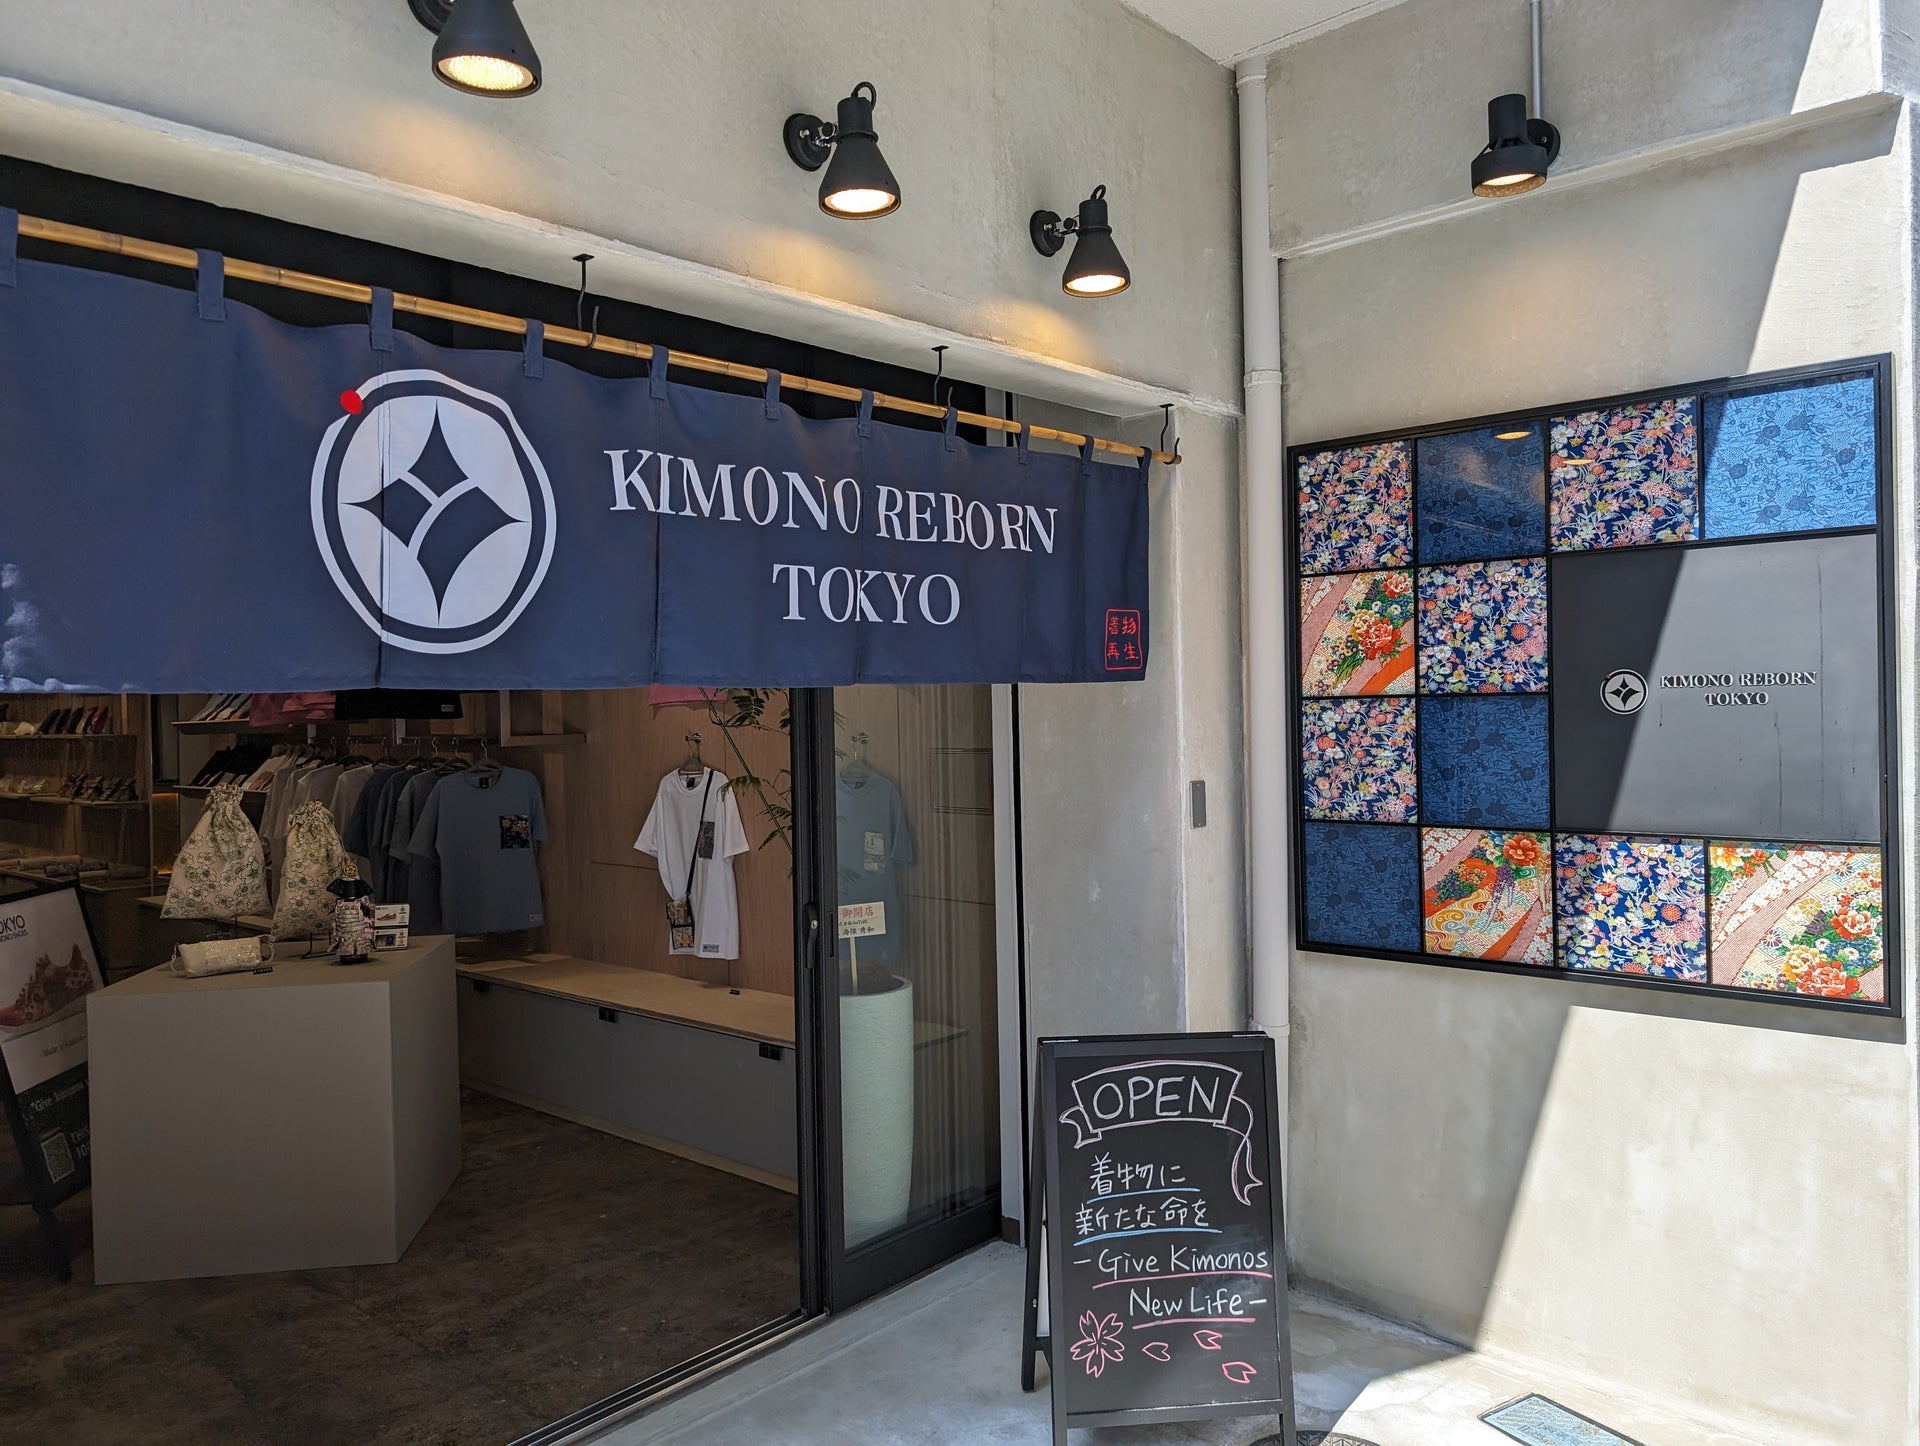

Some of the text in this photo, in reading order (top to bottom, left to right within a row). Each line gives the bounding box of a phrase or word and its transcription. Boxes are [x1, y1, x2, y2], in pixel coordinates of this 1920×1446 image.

[603, 449, 1058, 554] KIMONO REBORN
[772, 563, 960, 625] TOKYO
[1107, 642, 1139, 661] 再生
[1660, 671, 1818, 688] KIMONO REBORN
[1704, 692, 1770, 706] TOKYO
[1093, 1076, 1219, 1120] OPEN
[1089, 1152, 1186, 1193] 着物に
[1075, 1196, 1209, 1235] 新たな命を
[1170, 1245, 1268, 1272] Kimonos
[1129, 1288, 1182, 1316] New
